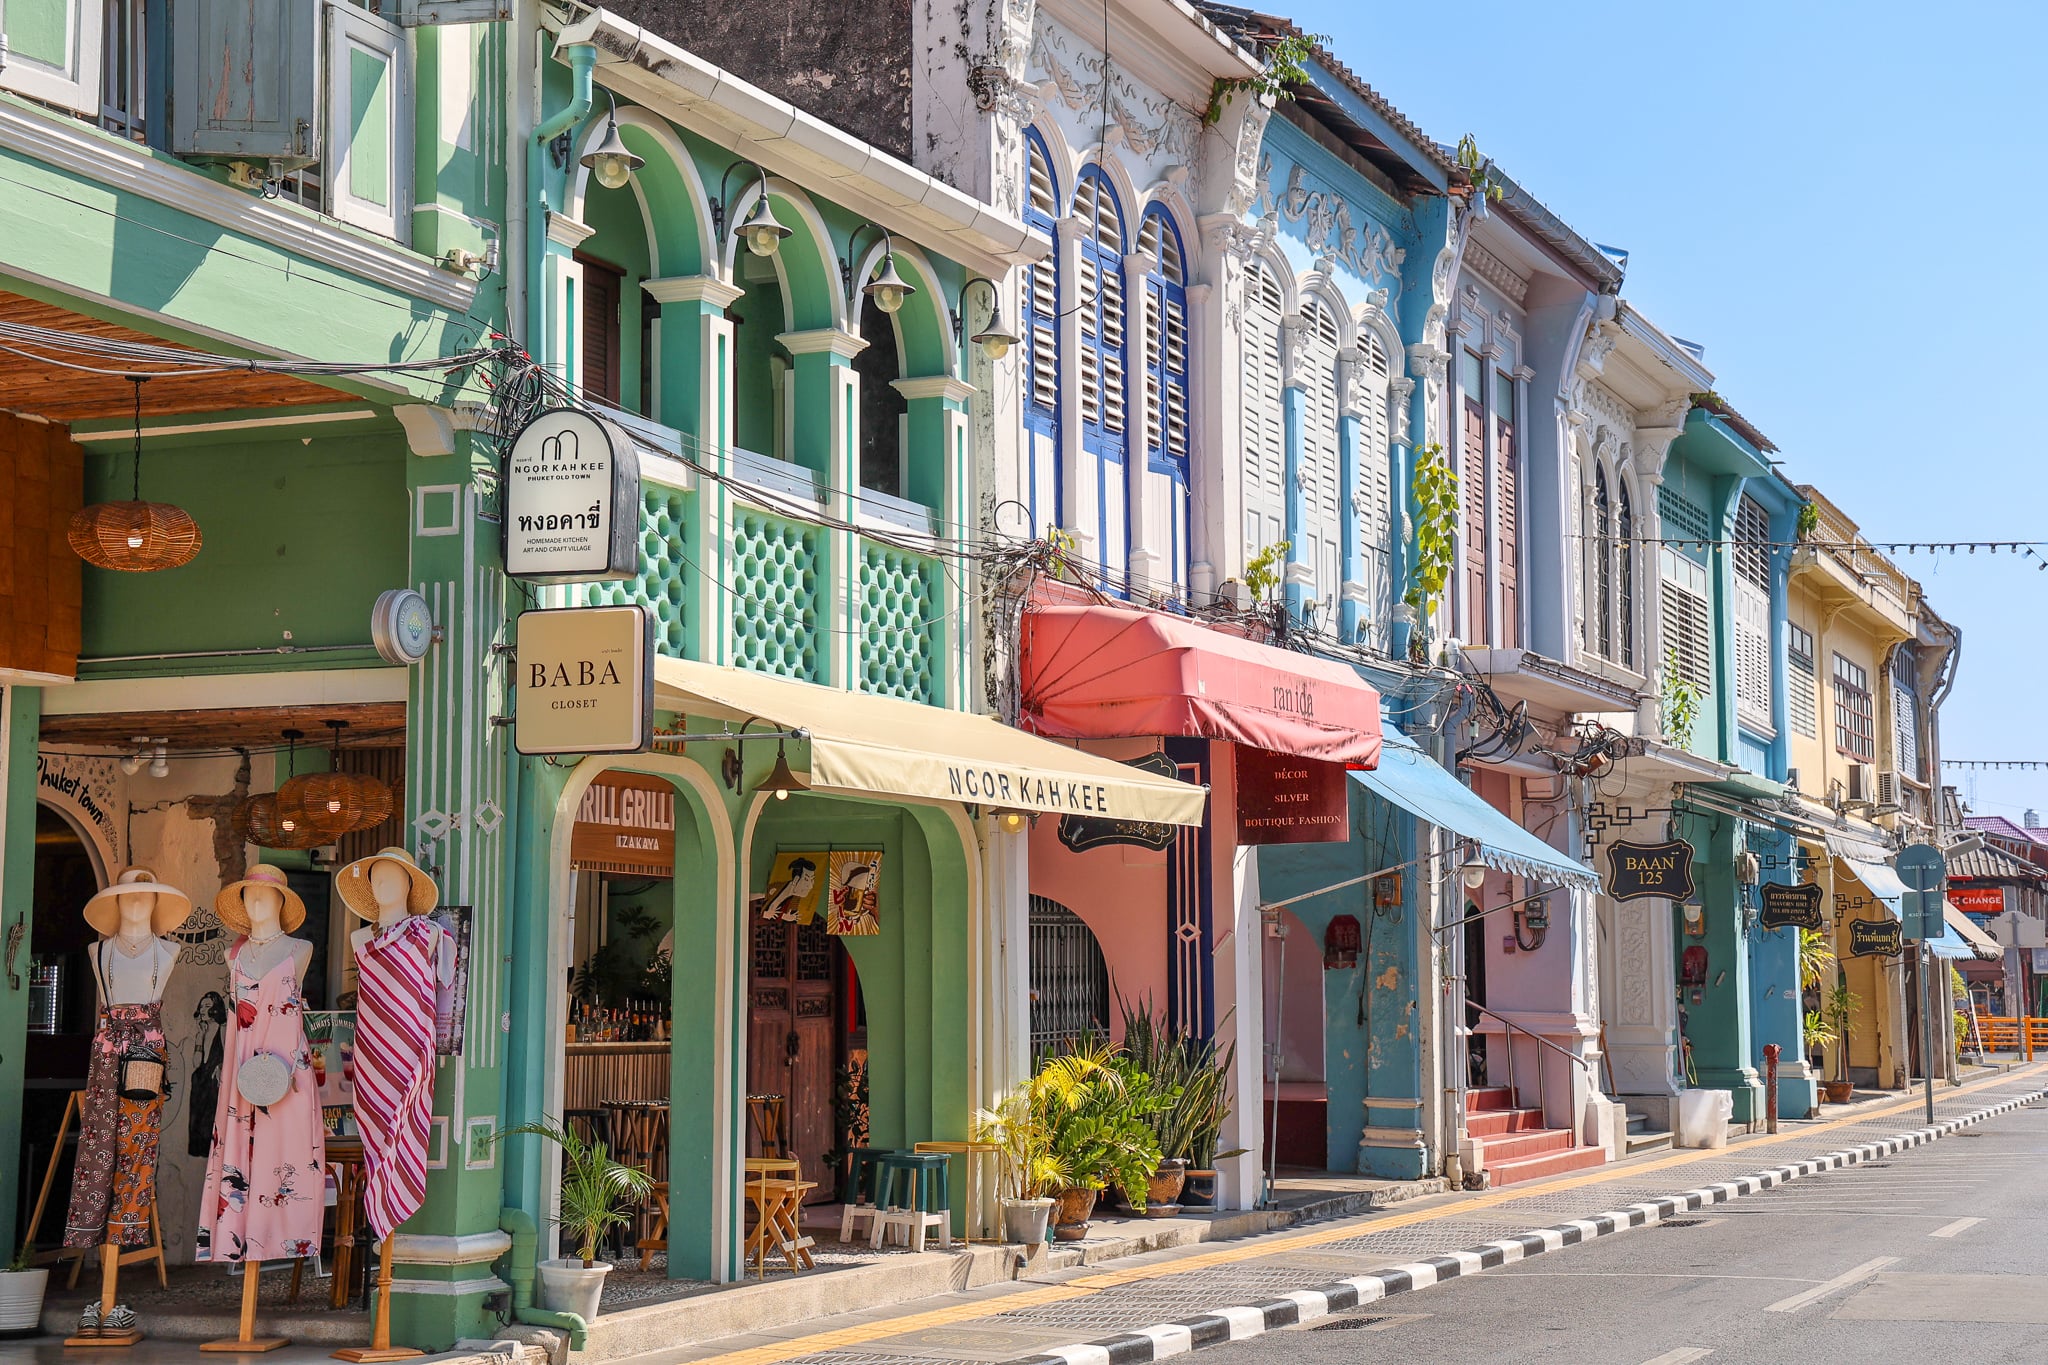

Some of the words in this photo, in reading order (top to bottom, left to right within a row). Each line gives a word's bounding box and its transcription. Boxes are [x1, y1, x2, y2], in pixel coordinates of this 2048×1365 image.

[552, 464, 577, 472] KAH
[581, 462, 604, 471] KEE
[529, 660, 621, 688] BABA
[551, 699, 597, 709] CLOSET
[1274, 768, 1309, 780] DÉCOR
[1019, 776, 1061, 807] KAH
[1067, 783, 1107, 812] KEE
[1274, 793, 1310, 803] SILVER
[78, 784, 105, 826] town
[1245, 817, 1295, 828] BOUTIQUE
[1299, 815, 1341, 825] FASHION
[616, 835, 660, 850] IZAKAYA
[1625, 857, 1675, 870] BAAN
[1639, 871, 1663, 885] 125
[310, 1018, 331, 1031] ALWAYS
[331, 1018, 355, 1030] SUMMER
